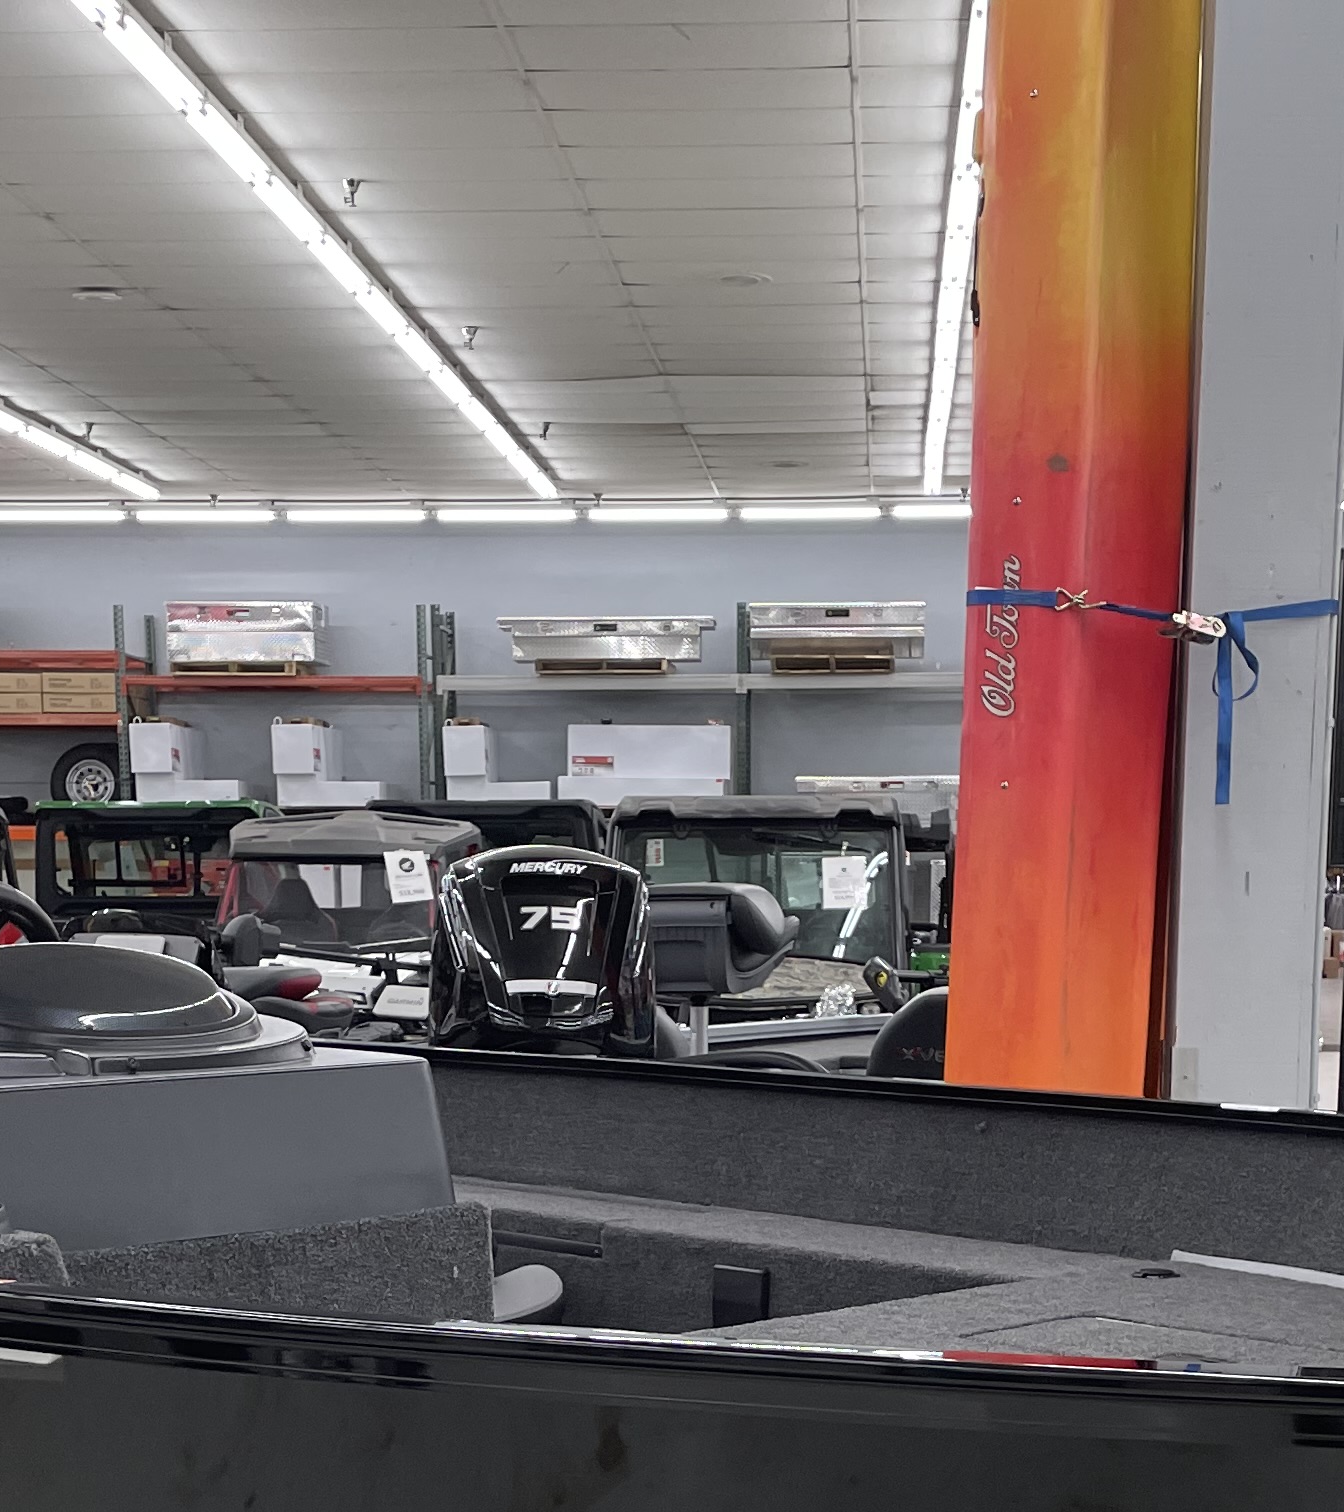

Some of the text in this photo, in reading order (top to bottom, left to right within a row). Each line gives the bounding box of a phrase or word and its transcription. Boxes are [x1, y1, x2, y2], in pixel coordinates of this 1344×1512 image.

[981, 649, 1016, 718] Old
[509, 861, 587, 875] MERCURY
[520, 906, 581, 931] 75
